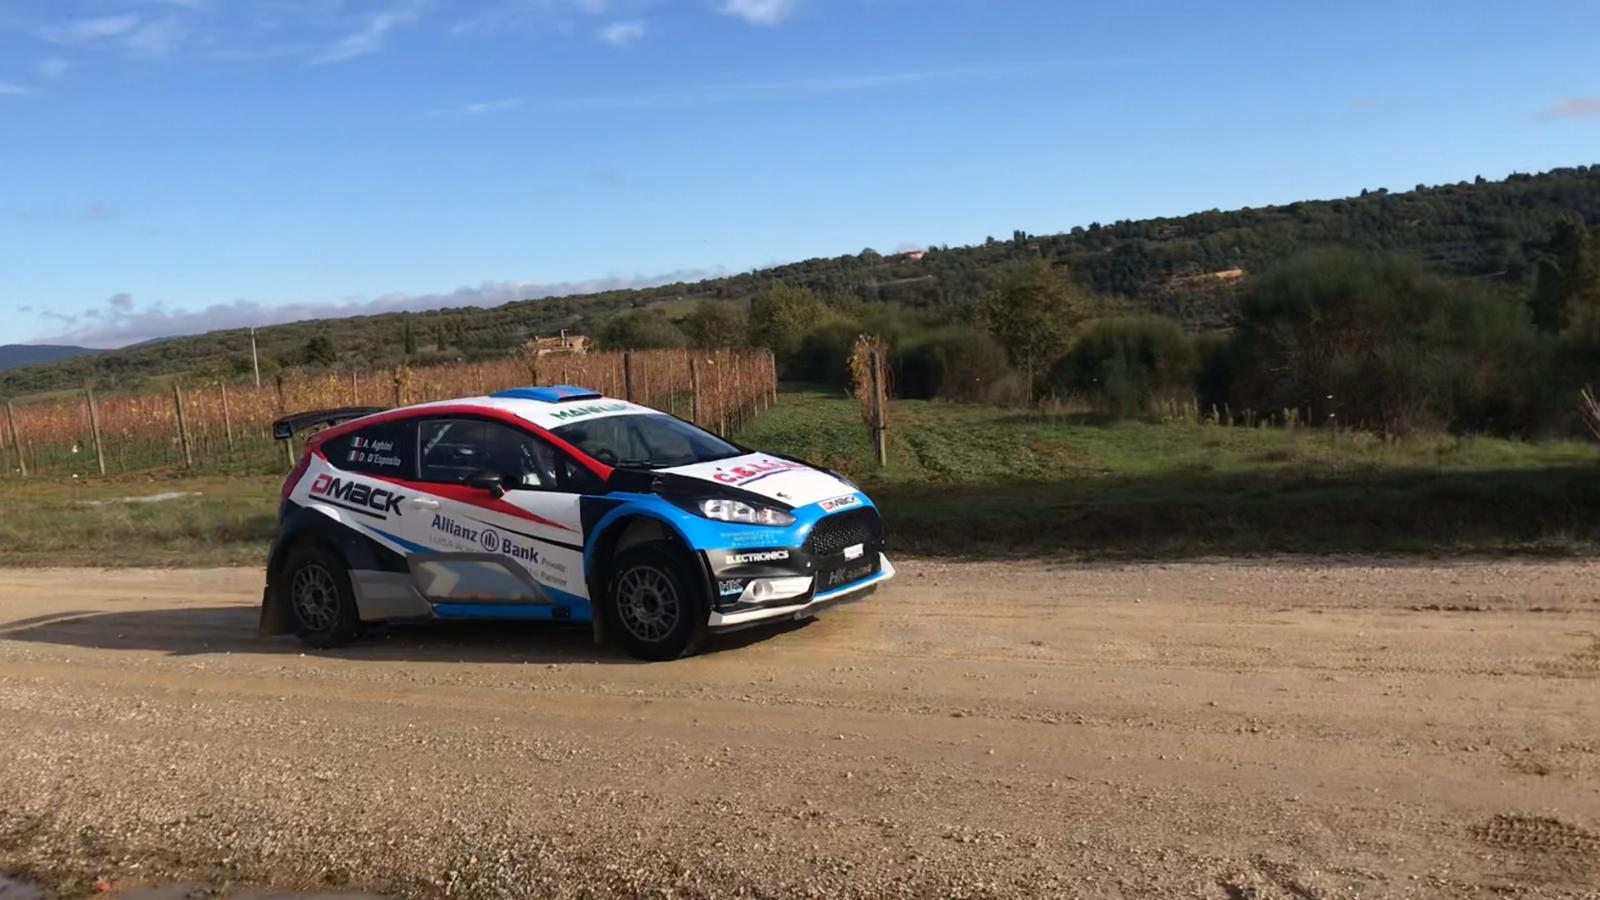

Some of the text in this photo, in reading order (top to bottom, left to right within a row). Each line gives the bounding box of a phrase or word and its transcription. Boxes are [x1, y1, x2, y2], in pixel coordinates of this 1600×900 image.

[432, 514, 539, 564] Allianz Bank
[725, 550, 789, 565] ELECTRONICS
